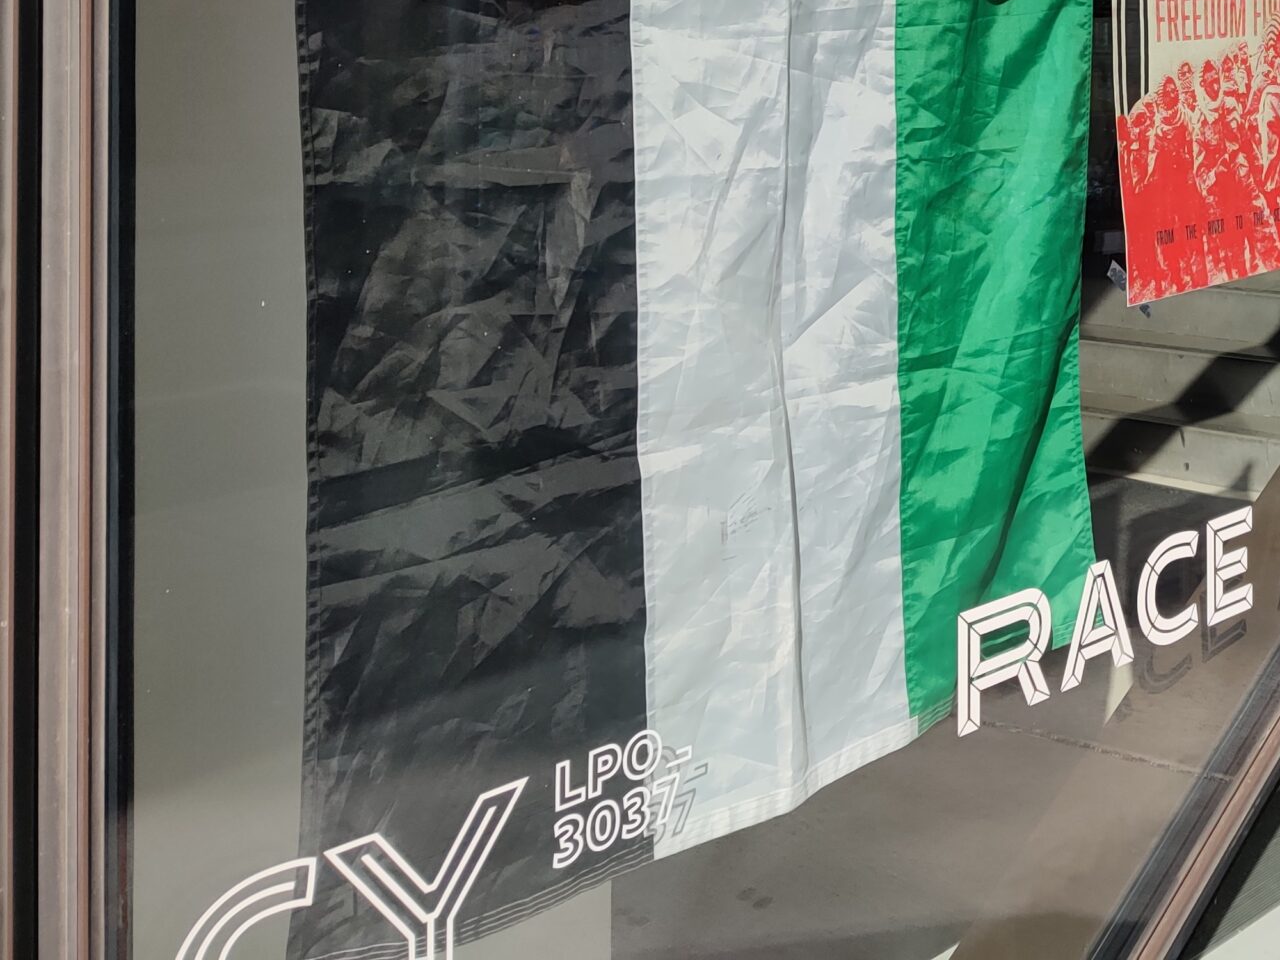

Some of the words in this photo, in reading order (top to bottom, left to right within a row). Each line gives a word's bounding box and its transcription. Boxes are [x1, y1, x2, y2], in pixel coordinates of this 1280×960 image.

[1156, 228, 1175, 246] FROM
[1185, 223, 1198, 240] THE
[1207, 218, 1225, 236] RIVER
[1235, 215, 1243, 230] TO
[957, 505, 1254, 738] RACE
[555, 729, 693, 813] LPO
[552, 772, 681, 869] 3037
